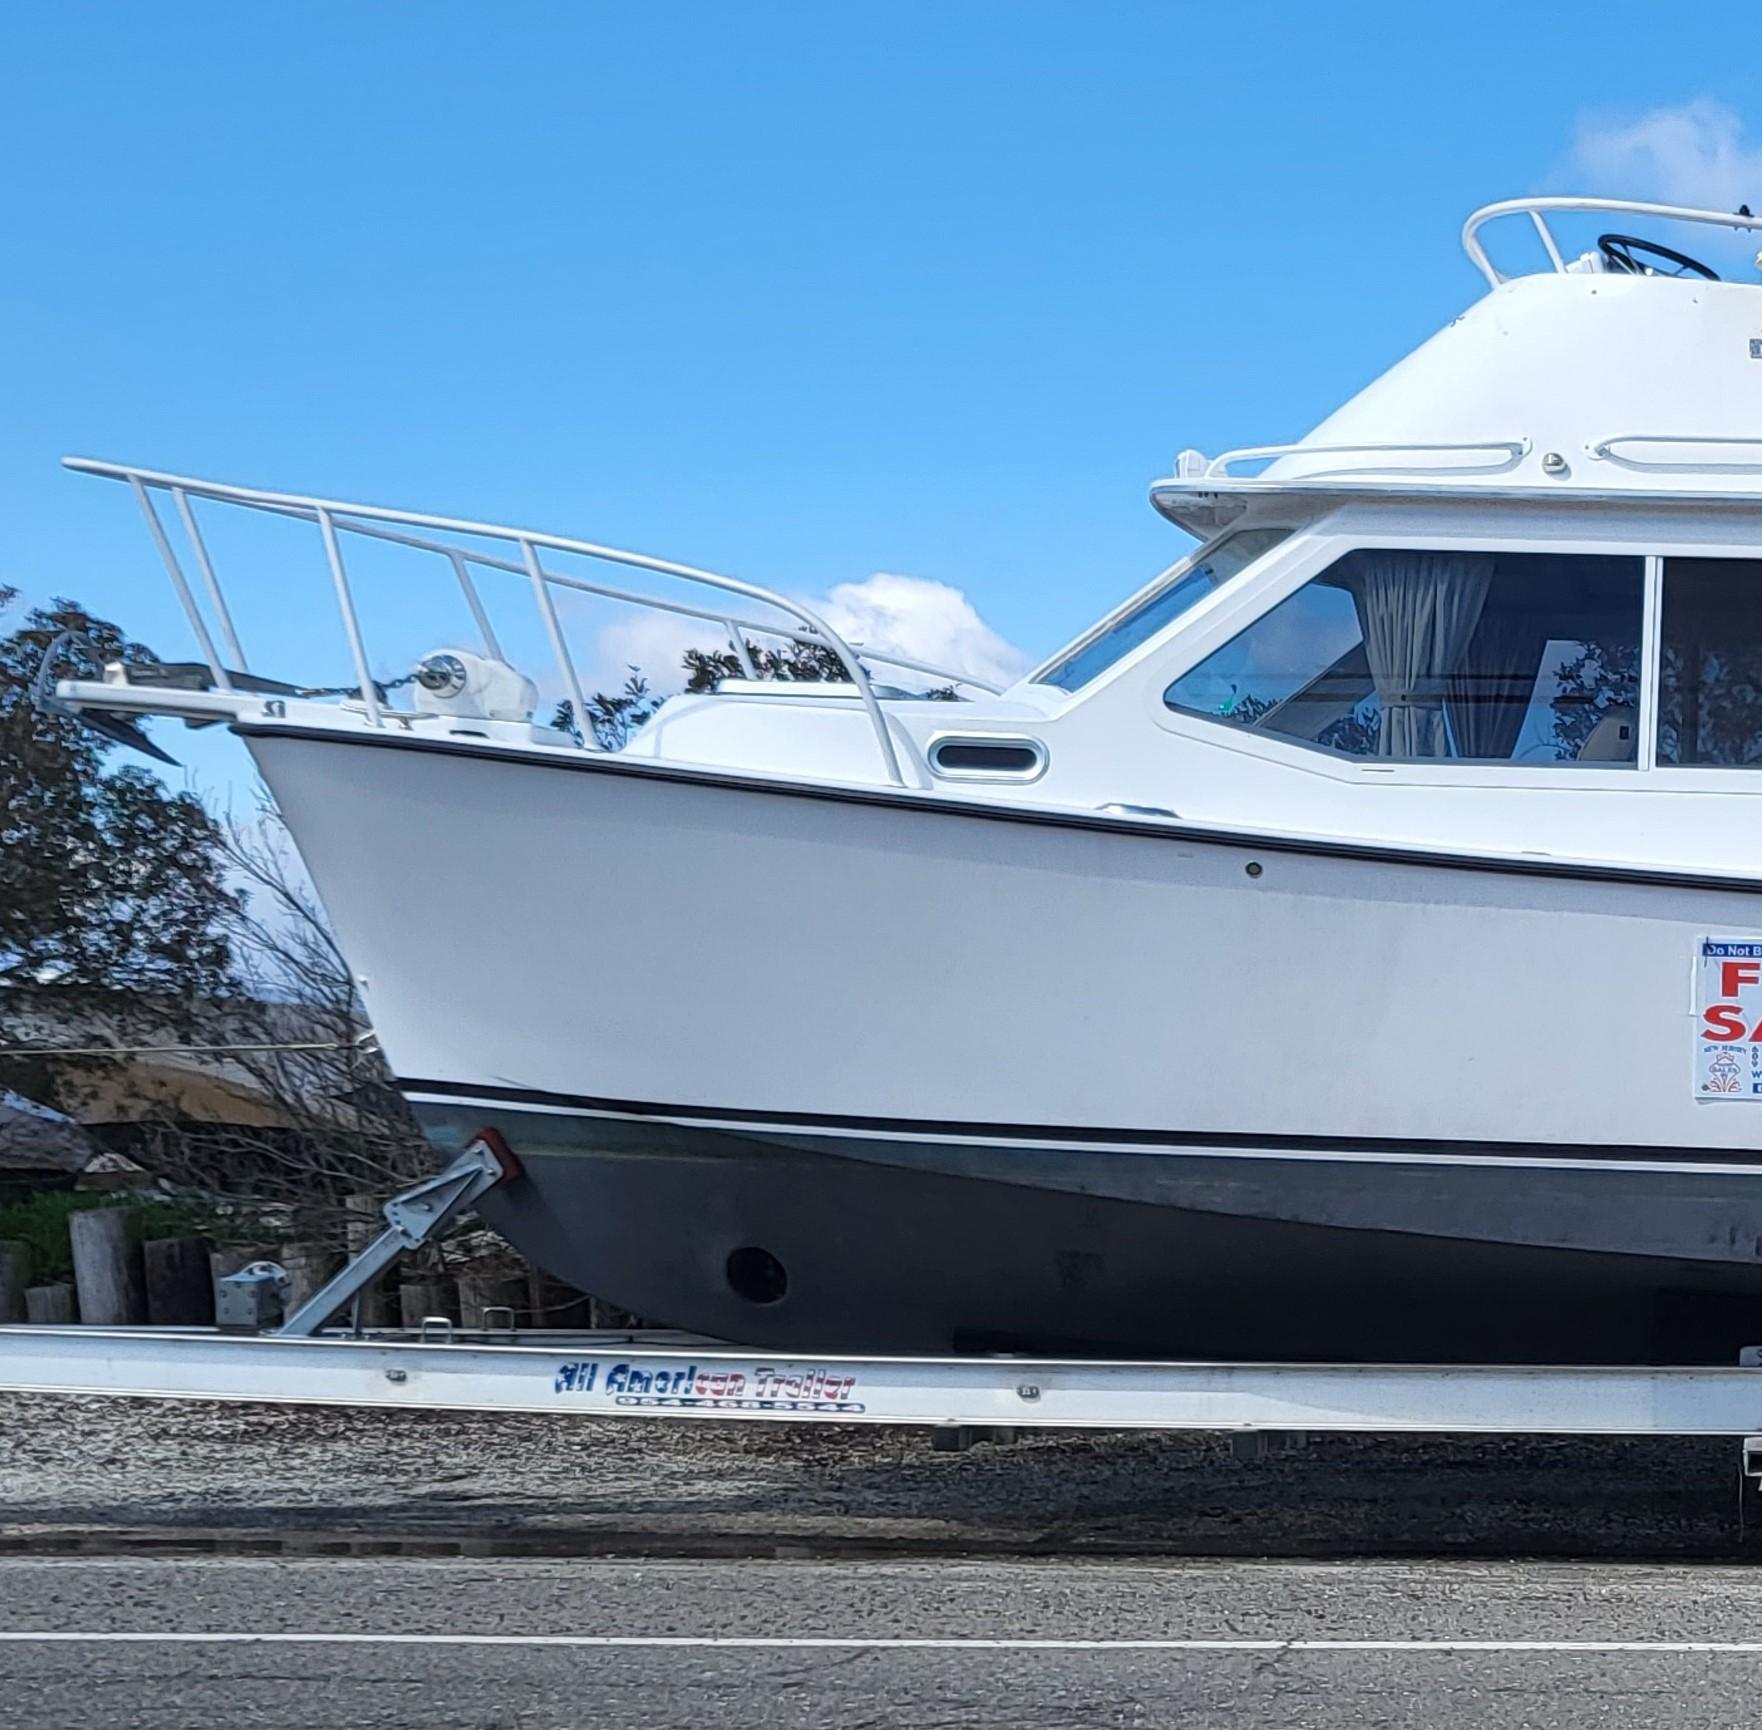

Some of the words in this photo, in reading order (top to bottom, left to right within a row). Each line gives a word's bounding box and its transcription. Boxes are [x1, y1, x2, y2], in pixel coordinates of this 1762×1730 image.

[1728, 945, 1750, 956] Not
[555, 1362, 598, 1394] All
[605, 1363, 745, 1397] American
[754, 1367, 856, 1400] Trailer
